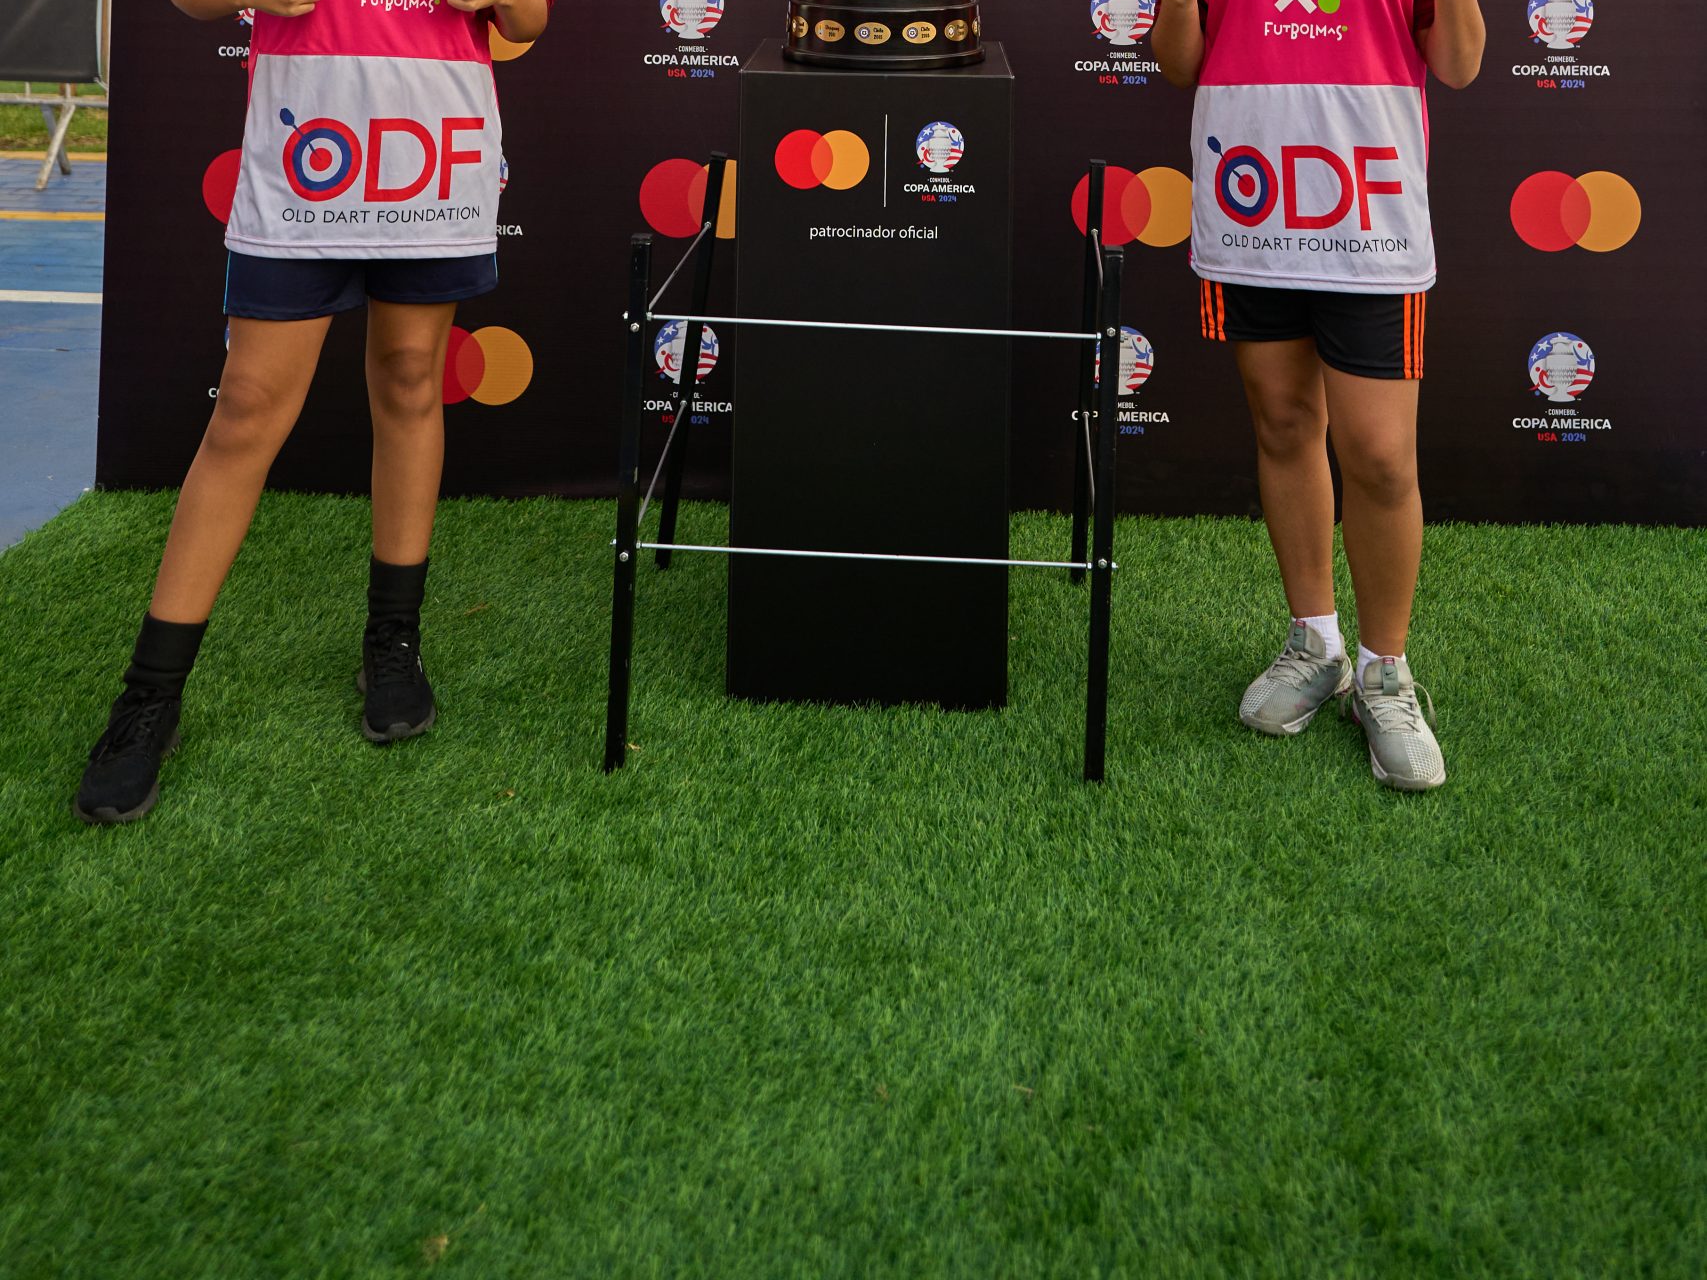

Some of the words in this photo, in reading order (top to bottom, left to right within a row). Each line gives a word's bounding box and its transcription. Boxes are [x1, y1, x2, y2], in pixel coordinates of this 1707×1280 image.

[218, 46, 250, 57] COPA
[643, 55, 678, 66] COPA
[680, 55, 739, 67] AMERICA
[1074, 61, 1110, 72] COPA
[667, 69, 686, 79] USA
[689, 69, 714, 79] 2024
[1511, 65, 1547, 76] COPA
[1549, 65, 1610, 76] AMERICA
[1098, 75, 1118, 85] USA
[1122, 76, 1146, 85] 2024
[1536, 79, 1556, 89] USA
[1560, 80, 1585, 89] 2024
[283, 117, 484, 202] ODF
[903, 184, 929, 193] COPA
[931, 185, 975, 194] AMERICA
[1215, 145, 1402, 231] ODF
[921, 195, 936, 203] USA
[938, 195, 956, 203] 2024
[282, 207, 315, 223] OLD
[323, 210, 370, 224] DART
[376, 205, 480, 224] FOUNDATION
[496, 224, 523, 236] RICA
[809, 225, 896, 240] patrocinador
[898, 225, 938, 240] oficial
[1222, 233, 1249, 248] OLD
[1252, 236, 1292, 251] DART
[1298, 237, 1408, 253] FOUNDATION
[643, 400, 673, 411] OPA
[692, 401, 733, 412] ERICA
[690, 415, 710, 425] 024
[1116, 411, 1170, 422] MERICA
[1119, 424, 1144, 435] 2024
[1512, 418, 1548, 429] COPA
[1550, 419, 1611, 430] AMERICA
[1537, 432, 1557, 442] USA
[1561, 433, 1586, 442] 2024
